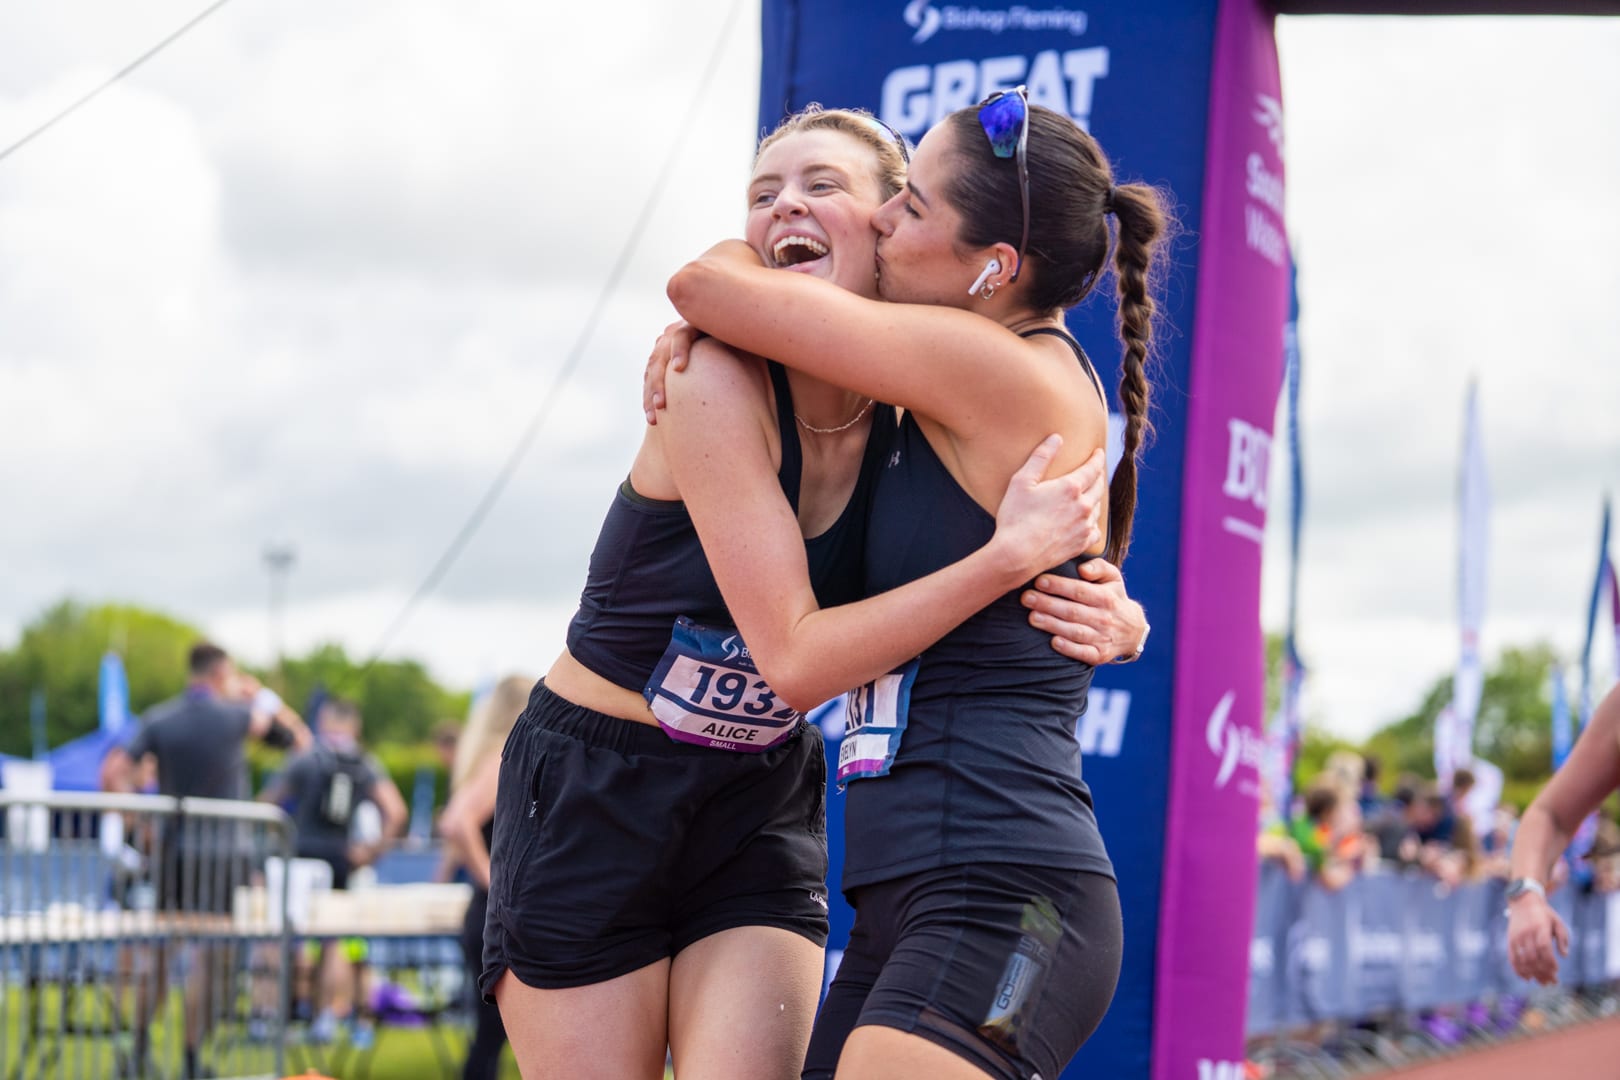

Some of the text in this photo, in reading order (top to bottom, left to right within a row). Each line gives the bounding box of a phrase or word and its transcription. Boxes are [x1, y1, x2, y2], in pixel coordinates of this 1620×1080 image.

[881, 46, 1109, 136] GREAT
[702, 722, 759, 741] ALICE
[709, 739, 737, 751] SMALL
